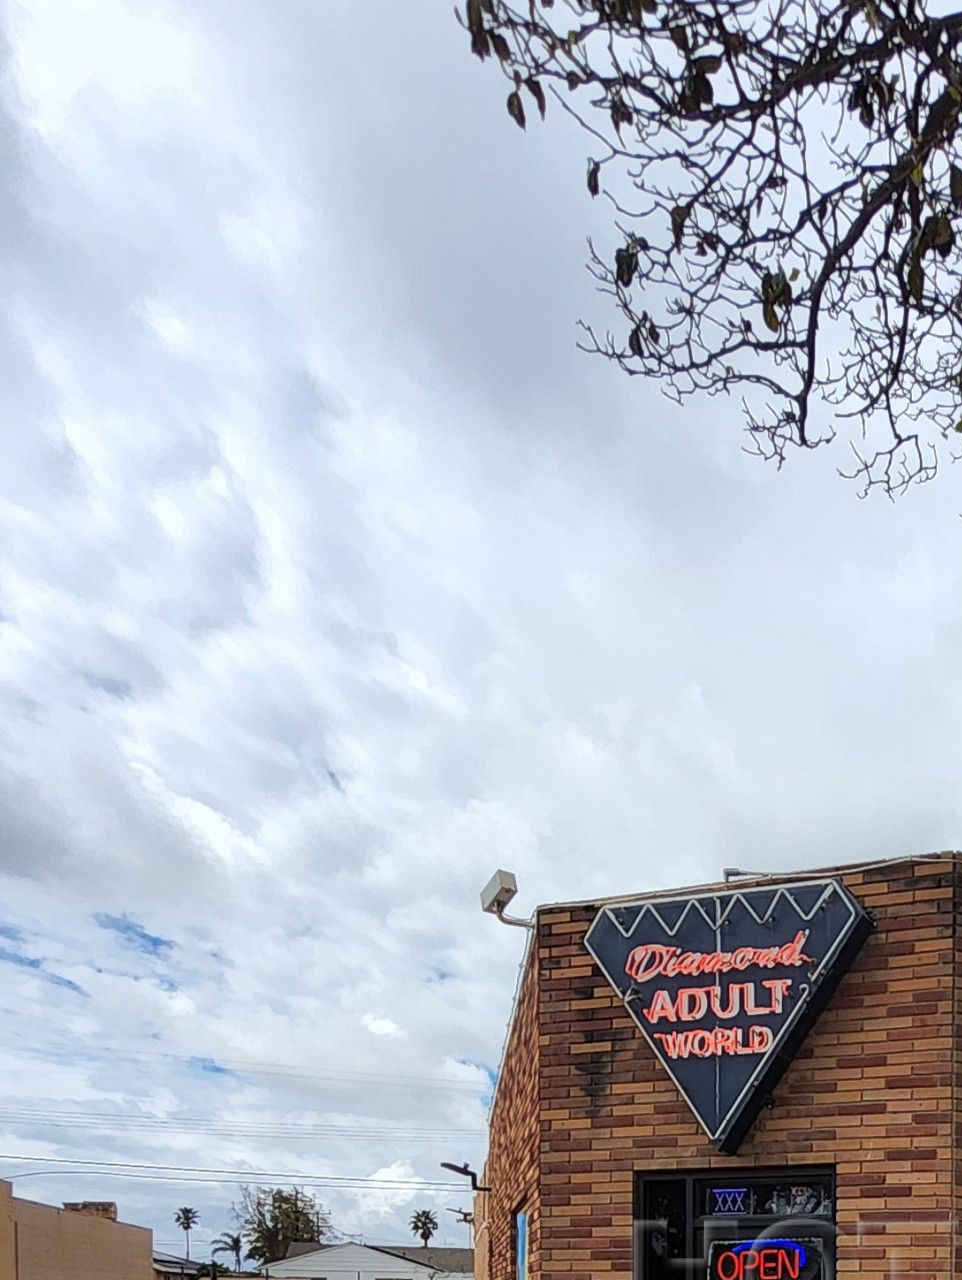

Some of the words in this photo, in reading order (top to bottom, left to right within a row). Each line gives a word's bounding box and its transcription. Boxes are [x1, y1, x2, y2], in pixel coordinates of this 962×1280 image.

[625, 929, 815, 982] Diamond
[643, 978, 793, 1024] ADULT
[653, 1025, 774, 1059] WORLD
[714, 1192, 745, 1212] XXX
